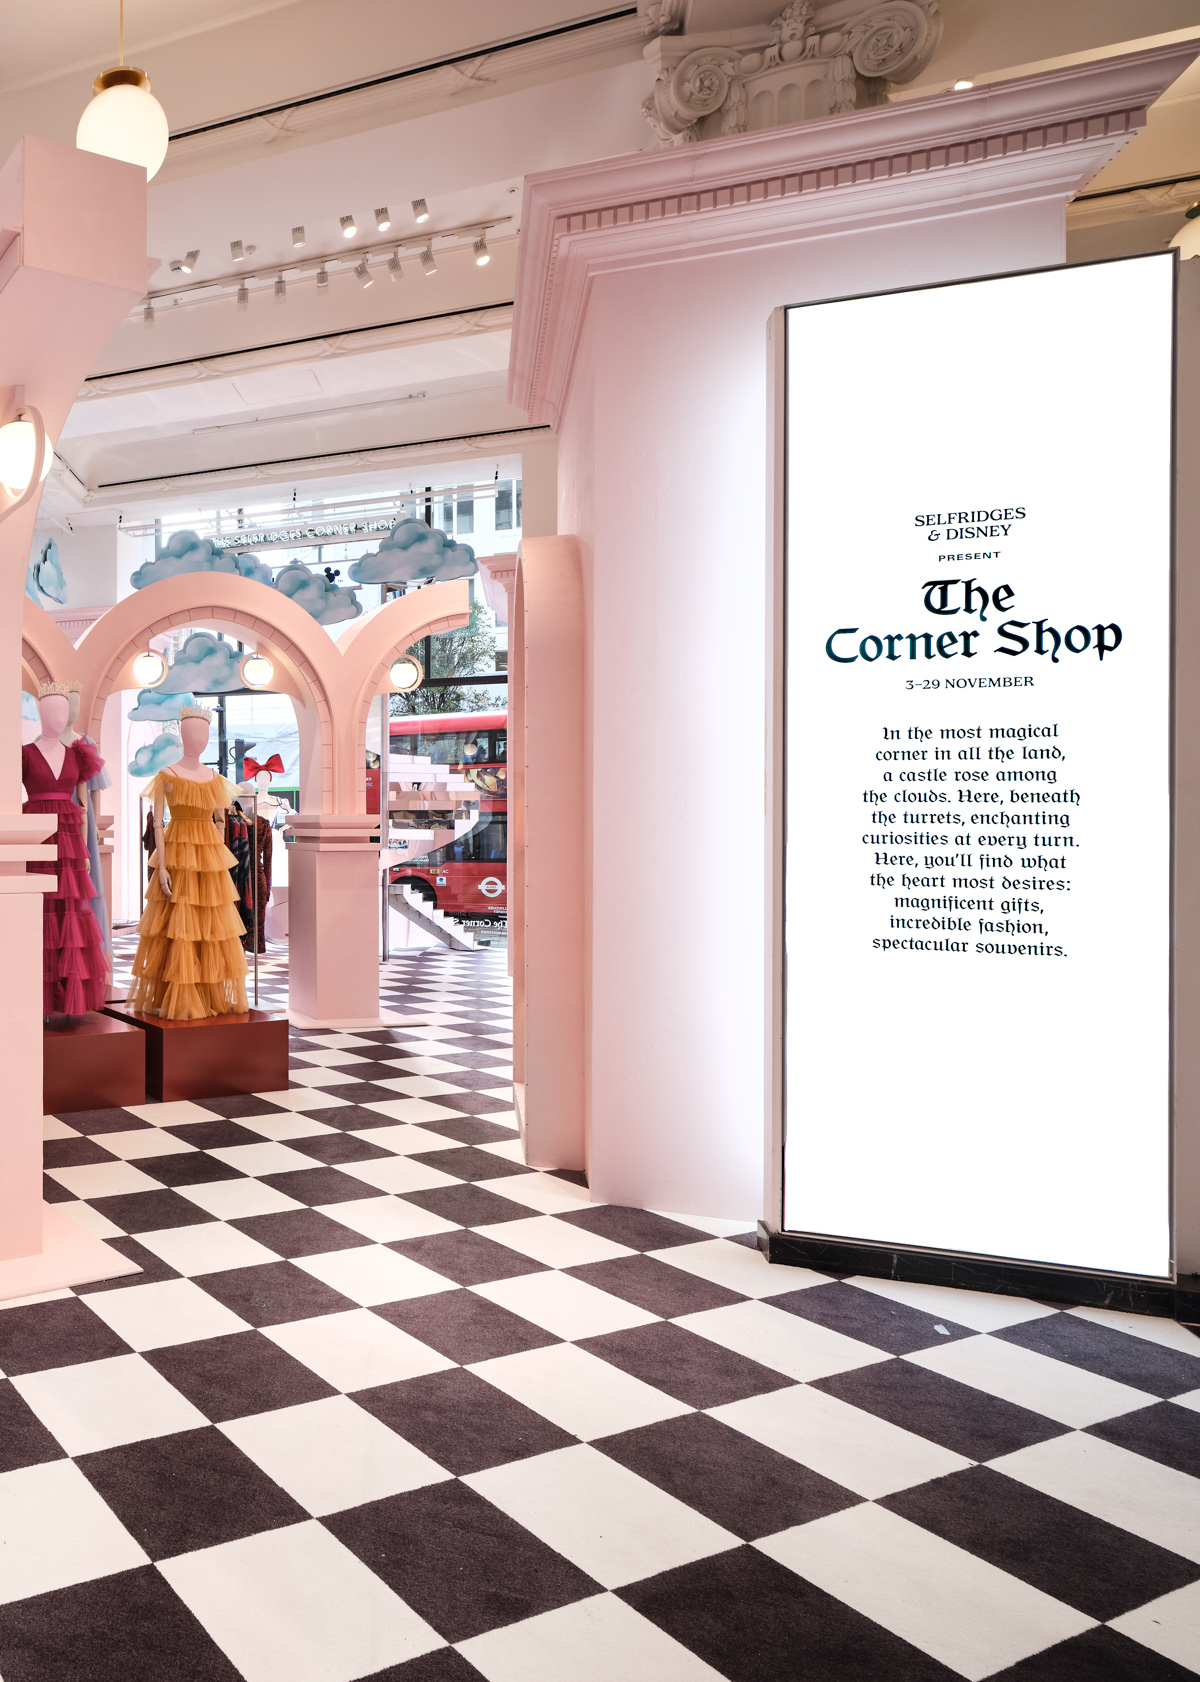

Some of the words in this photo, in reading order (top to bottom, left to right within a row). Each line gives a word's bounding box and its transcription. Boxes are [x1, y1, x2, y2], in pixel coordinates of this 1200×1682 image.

[915, 507, 1026, 526] SELFRIDGES
[211, 536, 231, 548] THE
[234, 529, 302, 547] SELFRIDGES
[305, 522, 357, 538] CORNER
[362, 519, 397, 533] SHOP
[928, 530, 940, 541] &
[947, 524, 1011, 540] DISNEY
[939, 552, 1000, 562] PRESENT
[921, 578, 1015, 622] The
[826, 628, 980, 663] Corner
[994, 619, 1122, 663] Shop
[946, 677, 1034, 688] NOVEMBER
[883, 727, 900, 740] In
[908, 727, 932, 742] the
[940, 726, 981, 739] most
[989, 724, 1058, 741] magical
[876, 750, 928, 761] corner
[935, 747, 951, 760] in
[958, 747, 981, 760] all
[988, 747, 1014, 763] the
[1022, 746, 1065, 761] land,
[884, 772, 892, 781] a
[900, 768, 947, 781] castle
[954, 771, 989, 781] rose
[996, 771, 1057, 784] among
[863, 790, 887, 805] the
[894, 790, 951, 802] clouds.
[958, 790, 1003, 805] Here,
[1010, 789, 1080, 806] beneath
[872, 811, 896, 826] the
[904, 811, 965, 826] turrets,
[971, 811, 1070, 828] enchanting
[862, 832, 948, 845] curiosities
[955, 833, 971, 845] at
[978, 836, 1027, 849] every
[1034, 834, 1079, 847] turn.
[874, 852, 918, 868] Here,
[980, 854, 1013, 870] find
[1021, 855, 1066, 871] what
[870, 873, 894, 889] the
[902, 874, 945, 889] heart
[953, 877, 994, 889] most
[1002, 876, 1070, 891] desires:
[895, 896, 994, 912] magnificent
[1001, 898, 1043, 914] gifts,
[890, 915, 971, 931] incredible
[979, 919, 1048, 936] fashion,
[873, 938, 968, 952] spectacular
[976, 942, 1067, 957] souvenirs.
